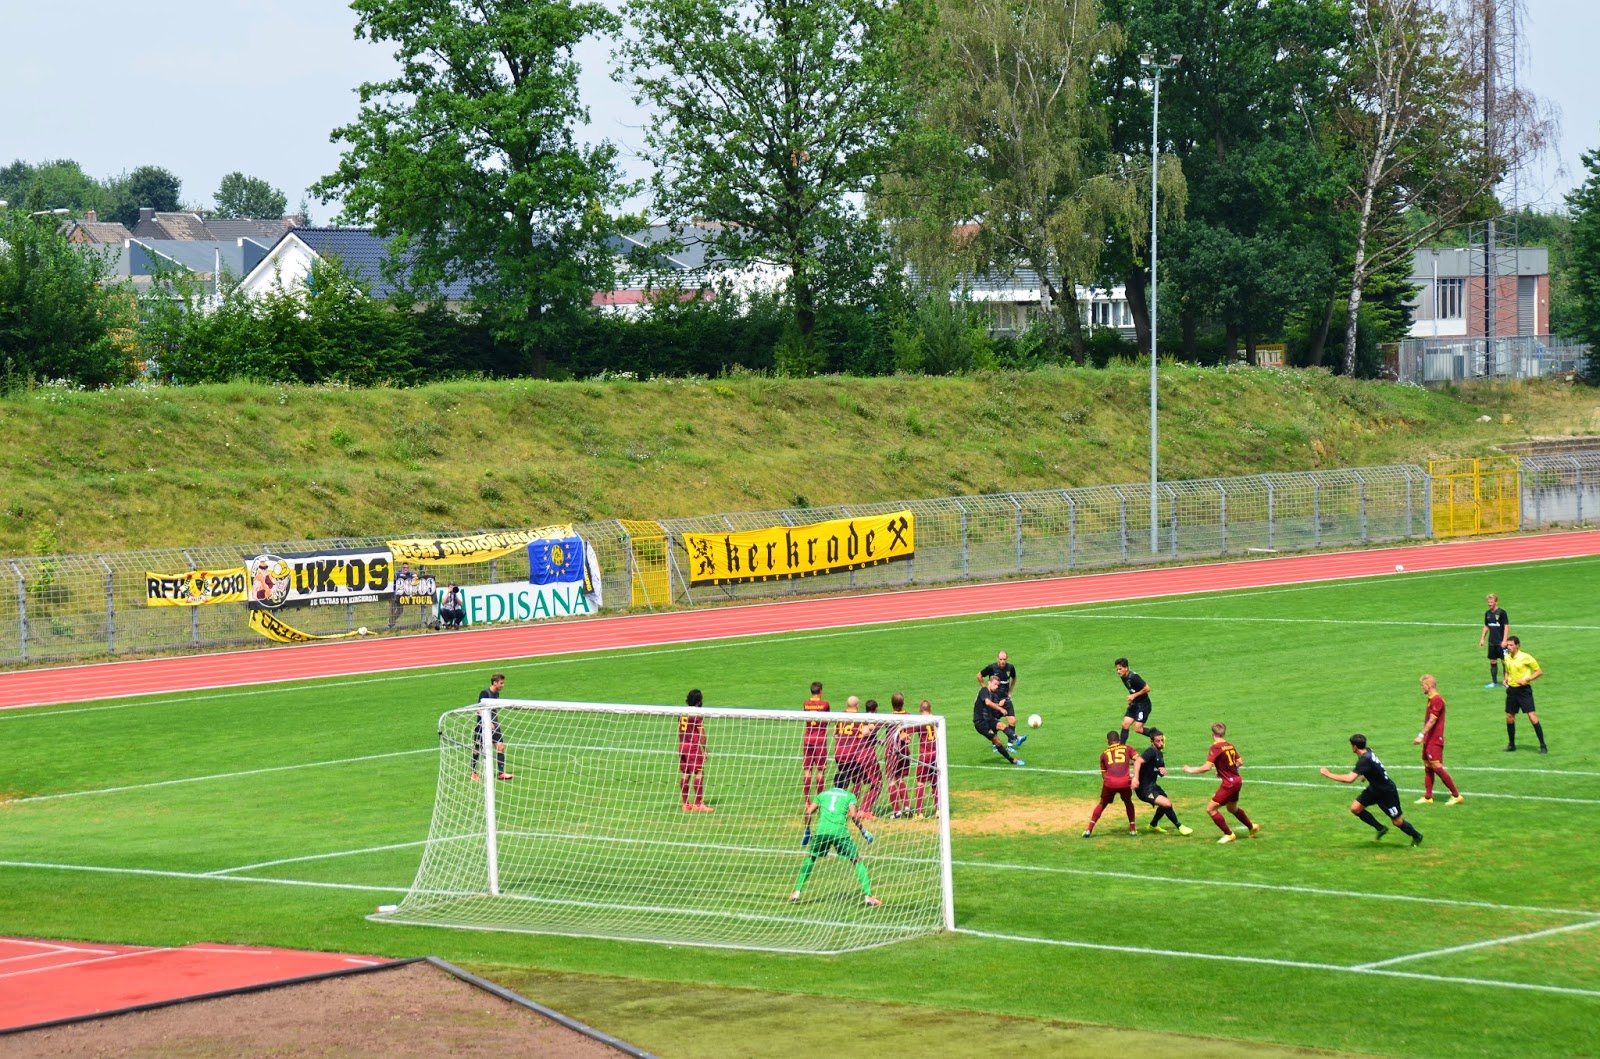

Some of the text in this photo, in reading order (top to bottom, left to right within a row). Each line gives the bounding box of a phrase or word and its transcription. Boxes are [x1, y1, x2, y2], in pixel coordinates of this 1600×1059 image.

[725, 521, 876, 574] kerkrade
[848, 557, 891, 571] OOST
[211, 573, 245, 597] 2010
[319, 597, 339, 605] ULTRAS
[400, 595, 433, 605] ON TOUR
[1106, 749, 1126, 765] 15
[828, 795, 837, 811] 1
